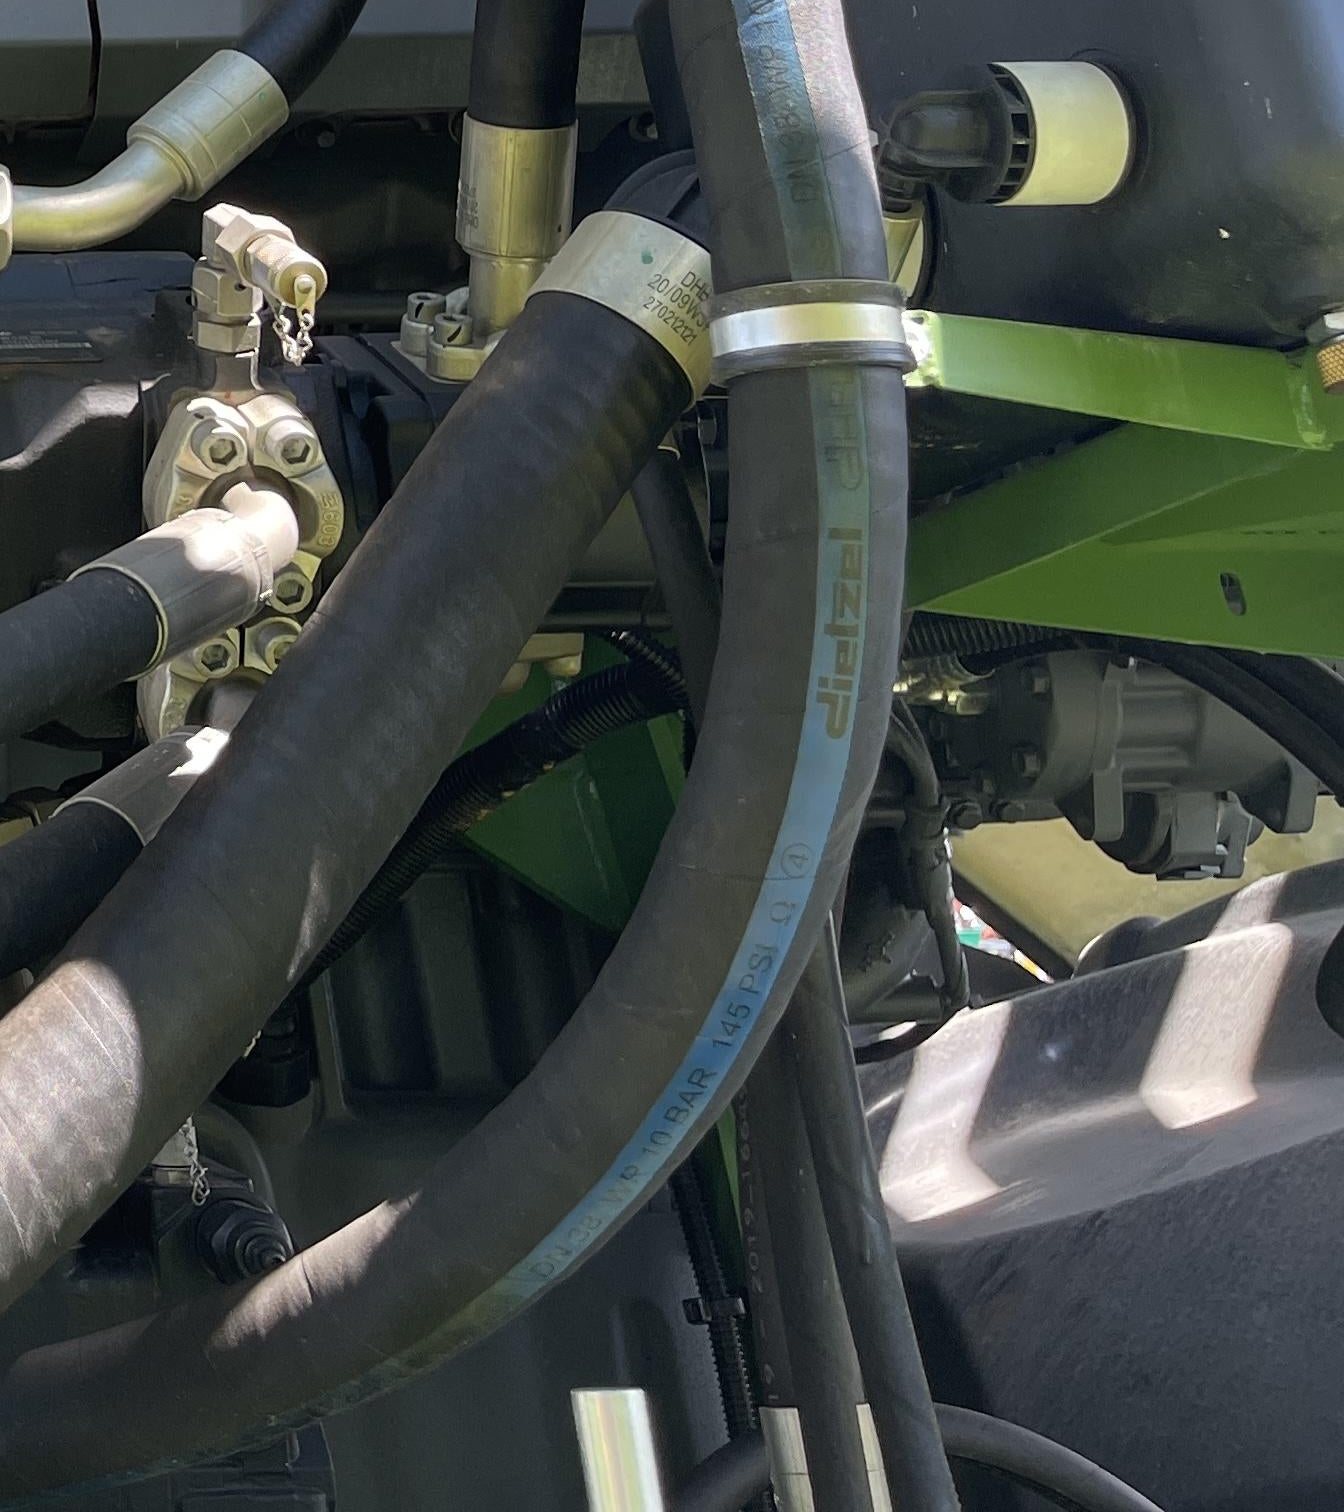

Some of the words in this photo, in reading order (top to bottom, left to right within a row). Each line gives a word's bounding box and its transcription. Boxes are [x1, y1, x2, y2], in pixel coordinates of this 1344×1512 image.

[643, 296, 698, 346] 270212121
[816, 527, 863, 740] dietzel
[642, 1130, 673, 1156] 10
[664, 1067, 719, 1124] BAR
[712, 1001, 751, 1048] 145
[738, 944, 779, 995] PSI
